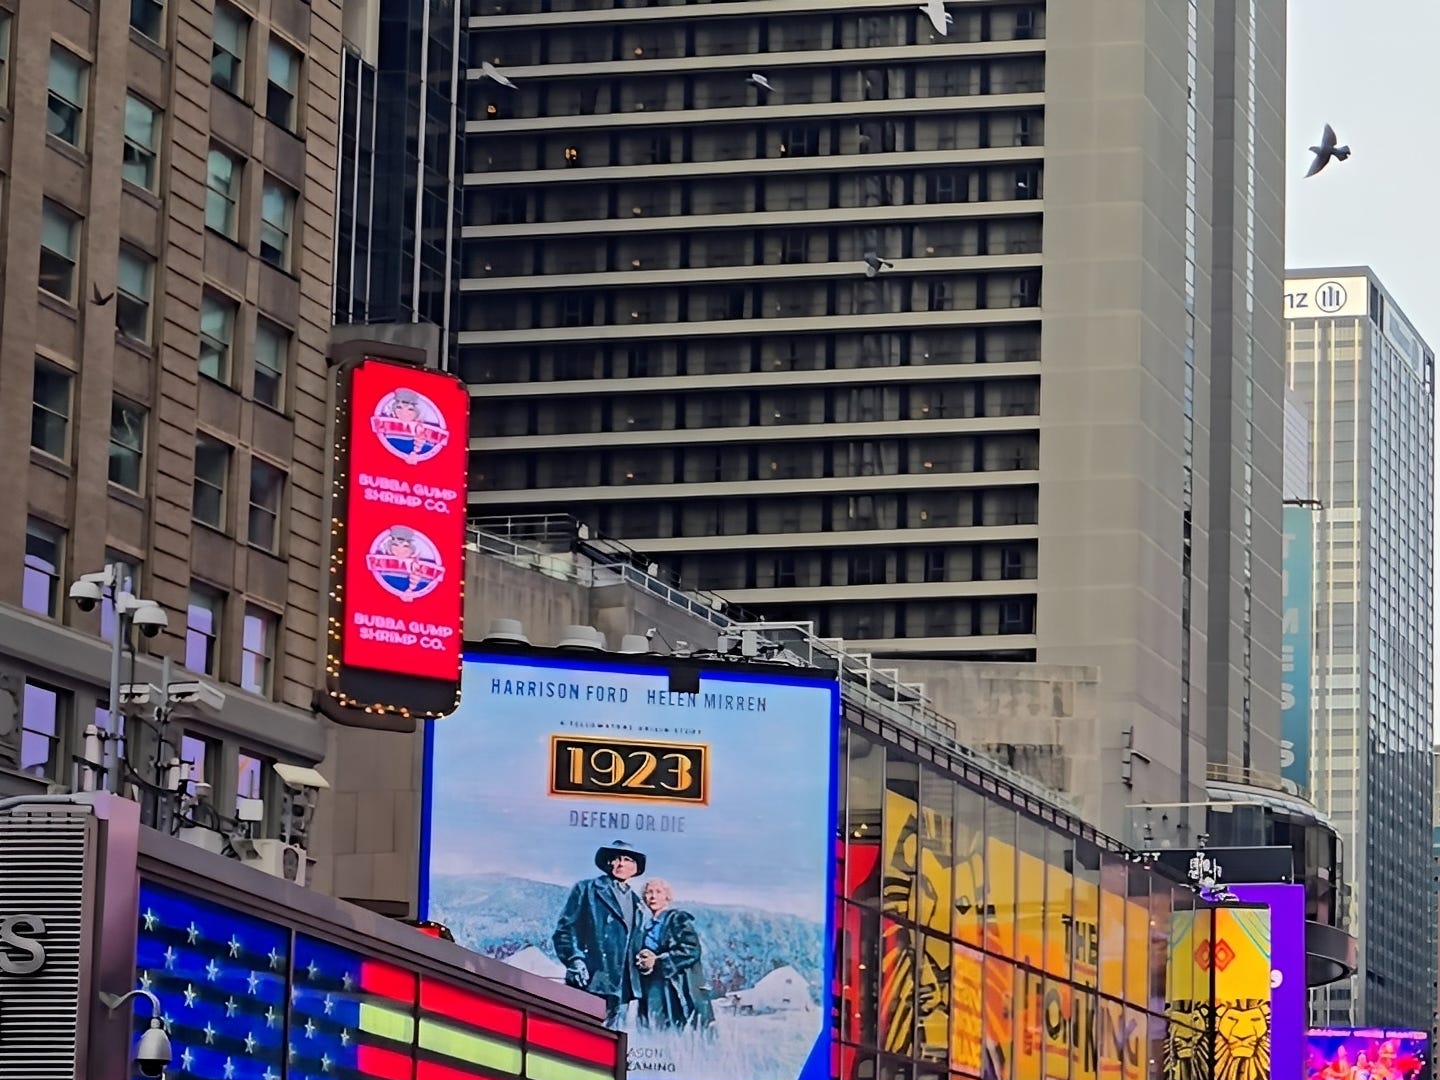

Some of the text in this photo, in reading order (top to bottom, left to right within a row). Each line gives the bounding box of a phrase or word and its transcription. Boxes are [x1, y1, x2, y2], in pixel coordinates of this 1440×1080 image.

[358, 473, 458, 501] BUBBA GUMP
[363, 488, 451, 514] SHRIMP CO.
[354, 612, 453, 638] BUBBA GUMP
[359, 627, 447, 651] SHRIMP CO.
[491, 678, 767, 713] HARRISON FORD HELEN MIRREN
[566, 746, 694, 792] 1923
[569, 809, 686, 833] DEFEND OR DIE
